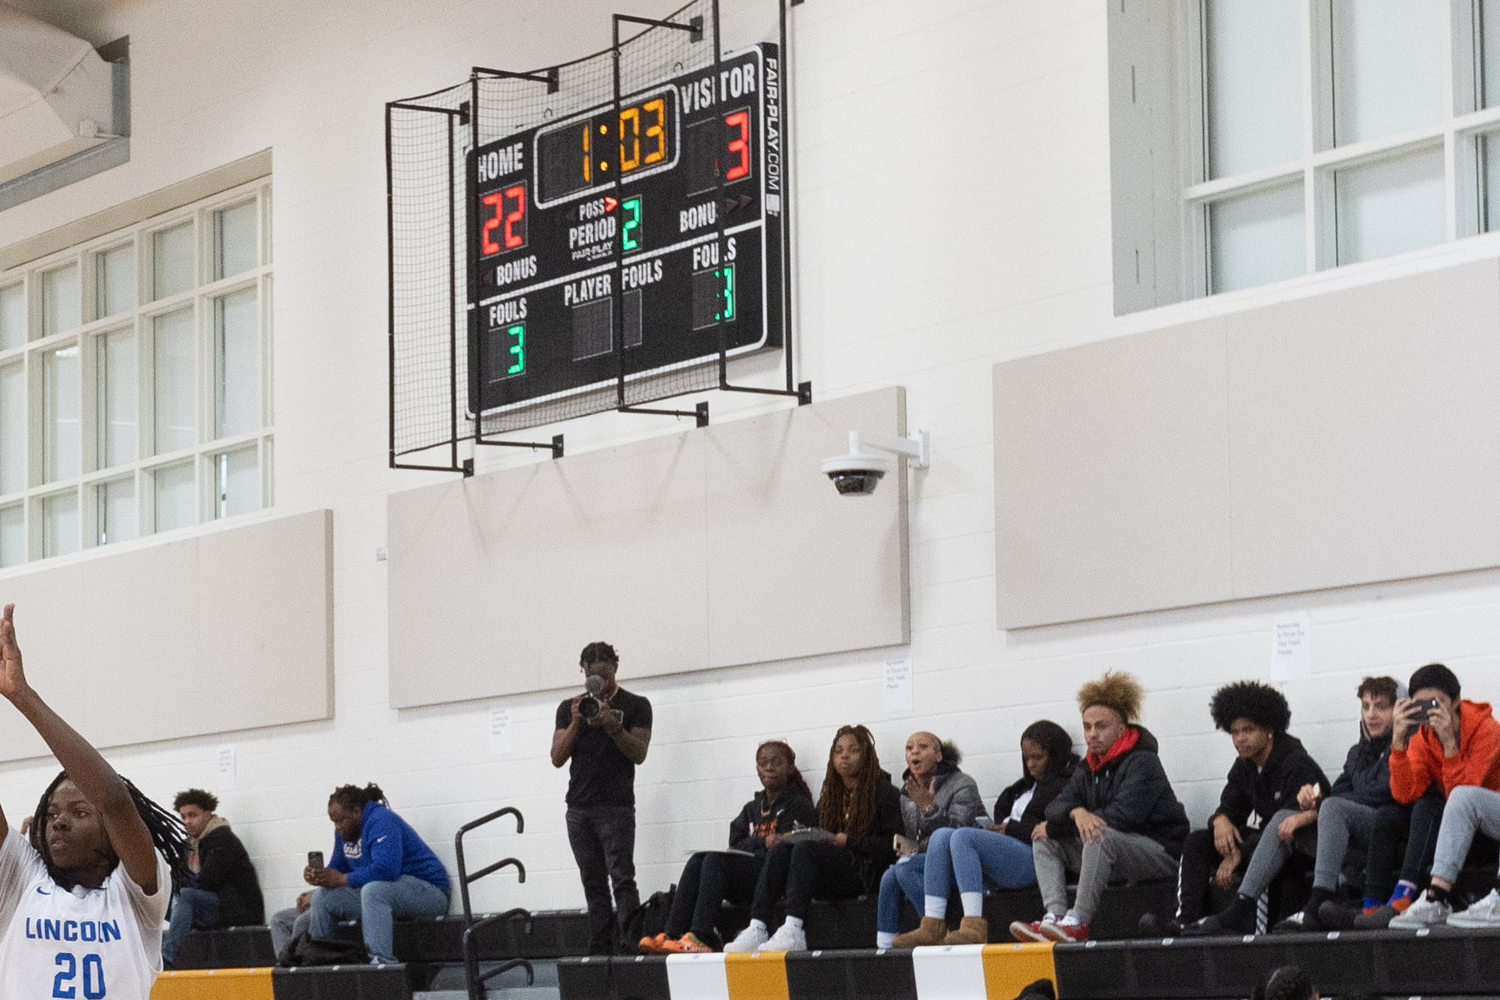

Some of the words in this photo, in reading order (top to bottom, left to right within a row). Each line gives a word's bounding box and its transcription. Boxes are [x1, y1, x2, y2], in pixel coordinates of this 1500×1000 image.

[583, 98, 666, 182] 1:03
[725, 111, 750, 180] 3
[766, 57, 781, 190] FAIR-PLAY.COM
[478, 142, 524, 183] HOME
[482, 186, 525, 256] 22
[579, 198, 605, 221] POSS
[622, 199, 640, 250] 2
[680, 201, 718, 232] BONU
[569, 216, 617, 249] PERIOD
[693, 237, 737, 270] FOUS
[496, 255, 538, 286] BONUS
[564, 274, 612, 306] PLAYER
[622, 259, 663, 290] FOULS
[489, 297, 528, 327] FOULS
[507, 325, 524, 374] 3
[25, 917, 122, 944] LINCOLN
[52, 952, 107, 1000] 20
